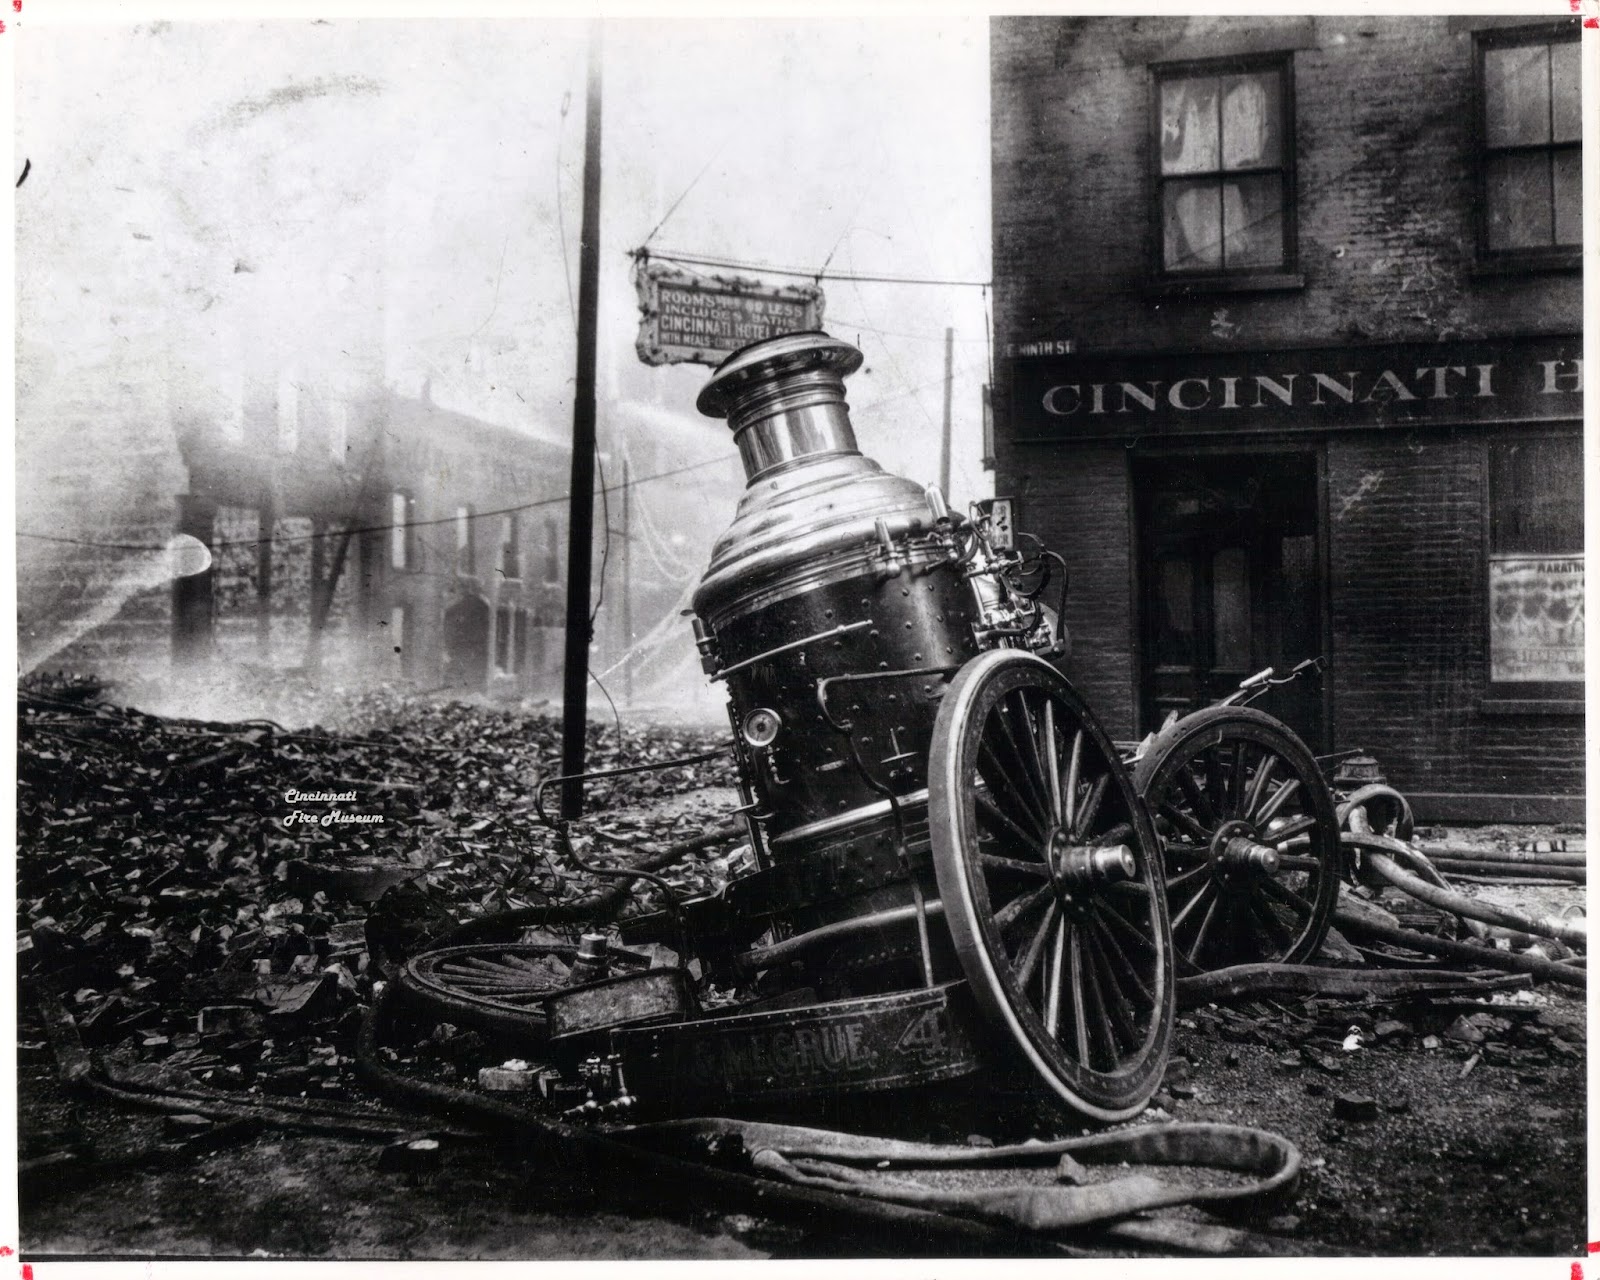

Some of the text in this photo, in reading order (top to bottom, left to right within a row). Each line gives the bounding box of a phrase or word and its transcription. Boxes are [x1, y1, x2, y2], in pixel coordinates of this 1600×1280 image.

[661, 290, 715, 308] ROOMS
[768, 302, 804, 318] LESS
[660, 314, 731, 337] CINCINNATI
[735, 322, 770, 340] HOTEL
[1018, 341, 1053, 356] NINTH
[1041, 364, 1497, 415] CINCINNATI
[895, 1005, 949, 1065] 4
